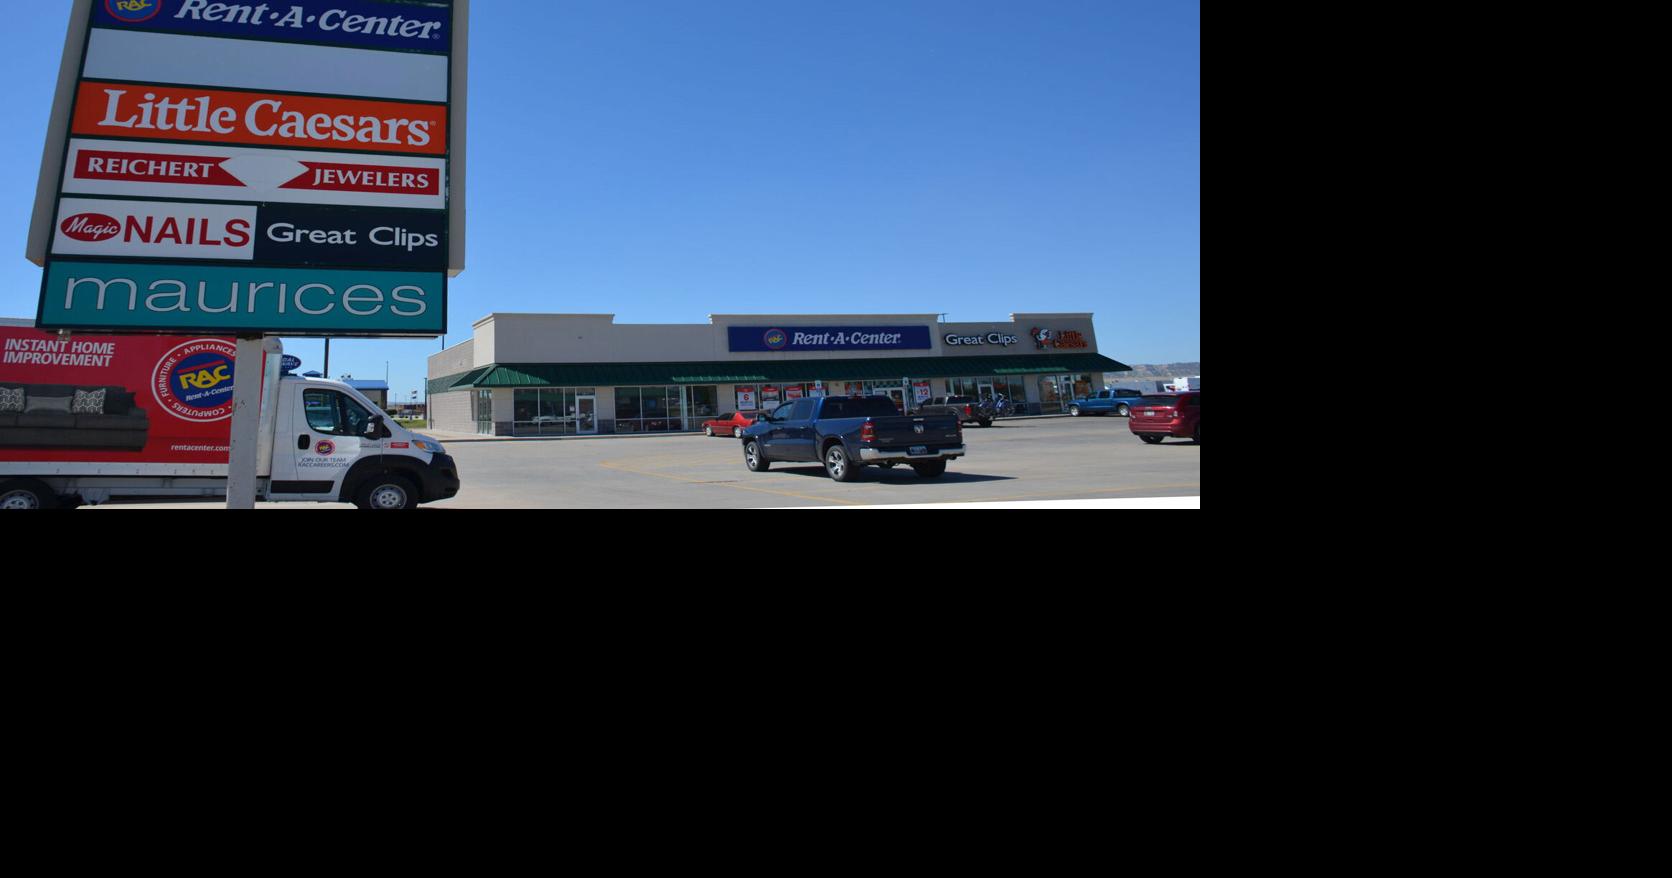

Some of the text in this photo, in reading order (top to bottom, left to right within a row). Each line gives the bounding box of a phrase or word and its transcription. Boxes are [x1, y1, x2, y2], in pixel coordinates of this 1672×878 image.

[97, 89, 431, 147] Little Caesars
[87, 156, 429, 189] REICHERT JEWELERS
[65, 214, 251, 248] Magic NAILS
[266, 222, 439, 251] Great Clips
[64, 276, 427, 317] maurices
[4, 339, 116, 354] INSTANT HOME
[945, 333, 1018, 347] Great Clips
[3, 351, 113, 367] IMPROVEMENT
[158, 357, 177, 398] FURNITURE
[179, 365, 231, 389] RAC
[172, 402, 225, 417] COMPUTERS
